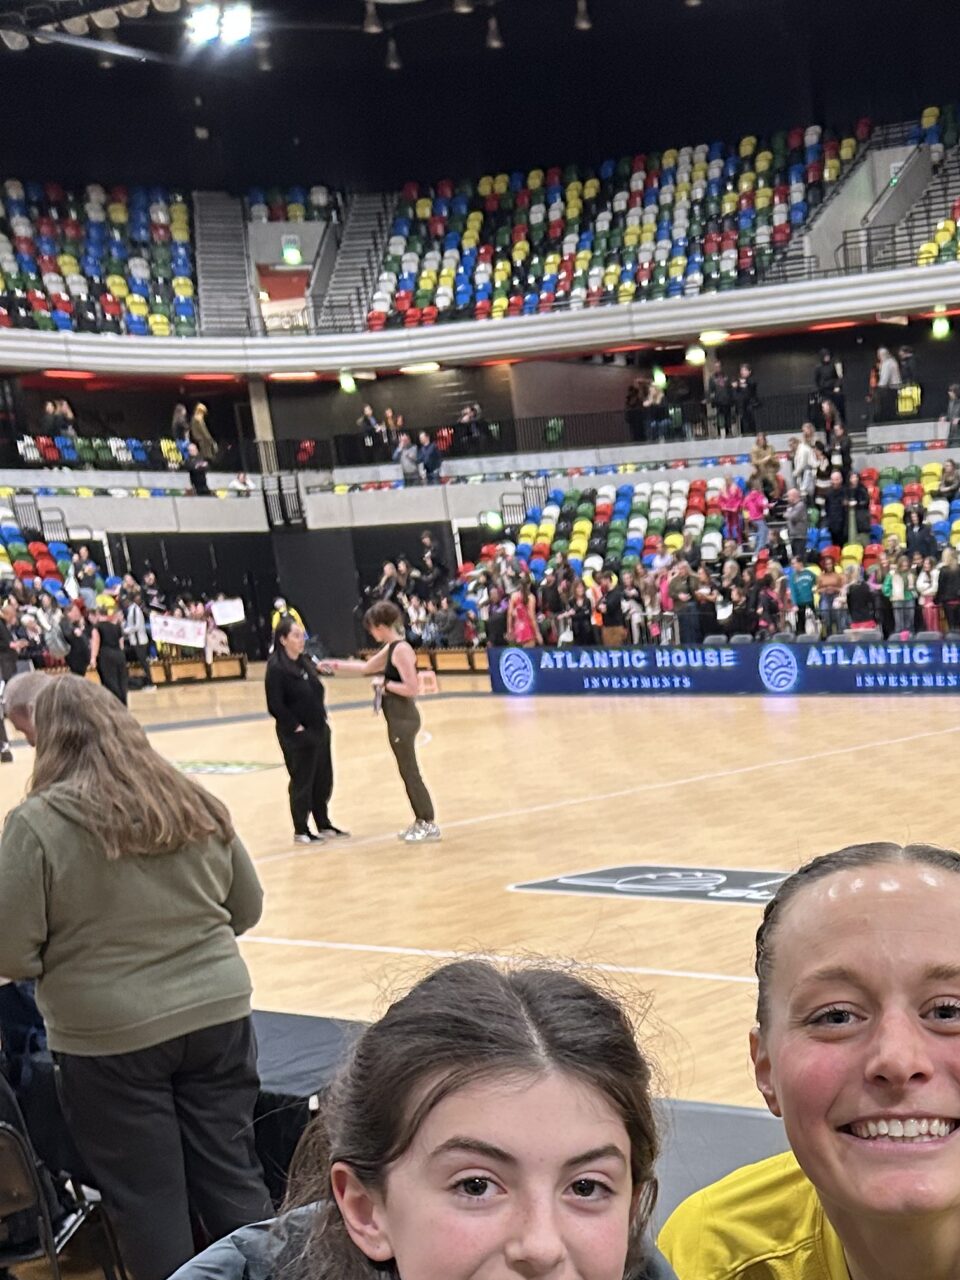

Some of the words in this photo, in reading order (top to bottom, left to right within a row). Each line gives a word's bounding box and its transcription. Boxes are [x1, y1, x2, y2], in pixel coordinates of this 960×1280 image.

[540, 650, 648, 669] ATLANTIC
[655, 649, 737, 667] HOUSE
[806, 646, 930, 665] ATLANTIC
[583, 676, 691, 688] INVESTMENTS
